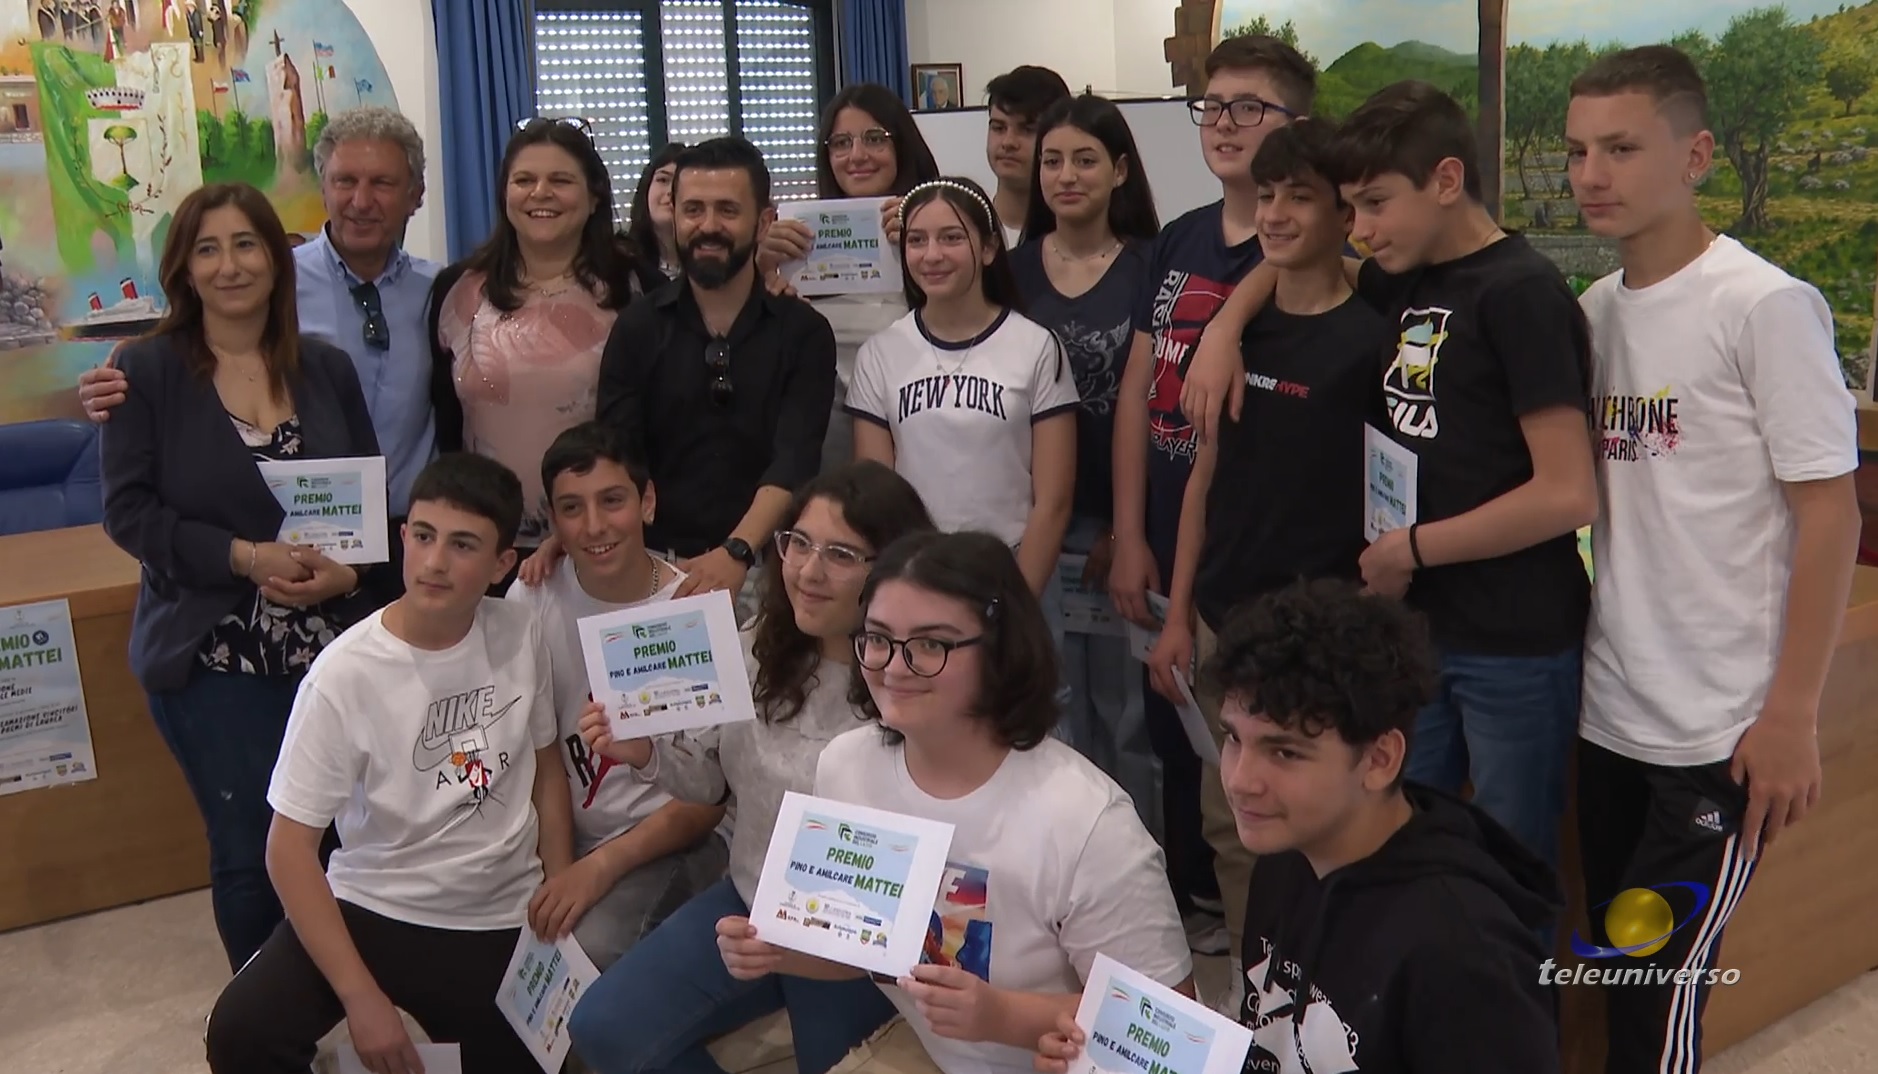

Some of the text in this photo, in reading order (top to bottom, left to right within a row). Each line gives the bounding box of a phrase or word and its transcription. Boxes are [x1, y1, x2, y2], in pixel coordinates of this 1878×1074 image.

[818, 228, 852, 239] PREMIO
[843, 239, 879, 250] MATTEI
[898, 374, 1007, 424] NEW YORK
[1602, 437, 1638, 462] PARIS
[290, 504, 362, 517] AMILCARE MATTEI
[294, 492, 333, 505] PREMIO
[0, 633, 29, 651] MIO
[633, 639, 677, 660] PREMIO
[609, 650, 713, 680] PINO E AMILCARE MATTEI
[425, 684, 495, 742] NIKE
[826, 847, 875, 871] PREMIO
[790, 860, 904, 899] PINO E AMILCARE MATTEI
[1092, 1031, 1109, 1047] PINO
[1109, 1040, 1116, 1051] E
[1116, 1045, 1150, 1071] AMILCARE
[1126, 1022, 1171, 1058] PREMIO
